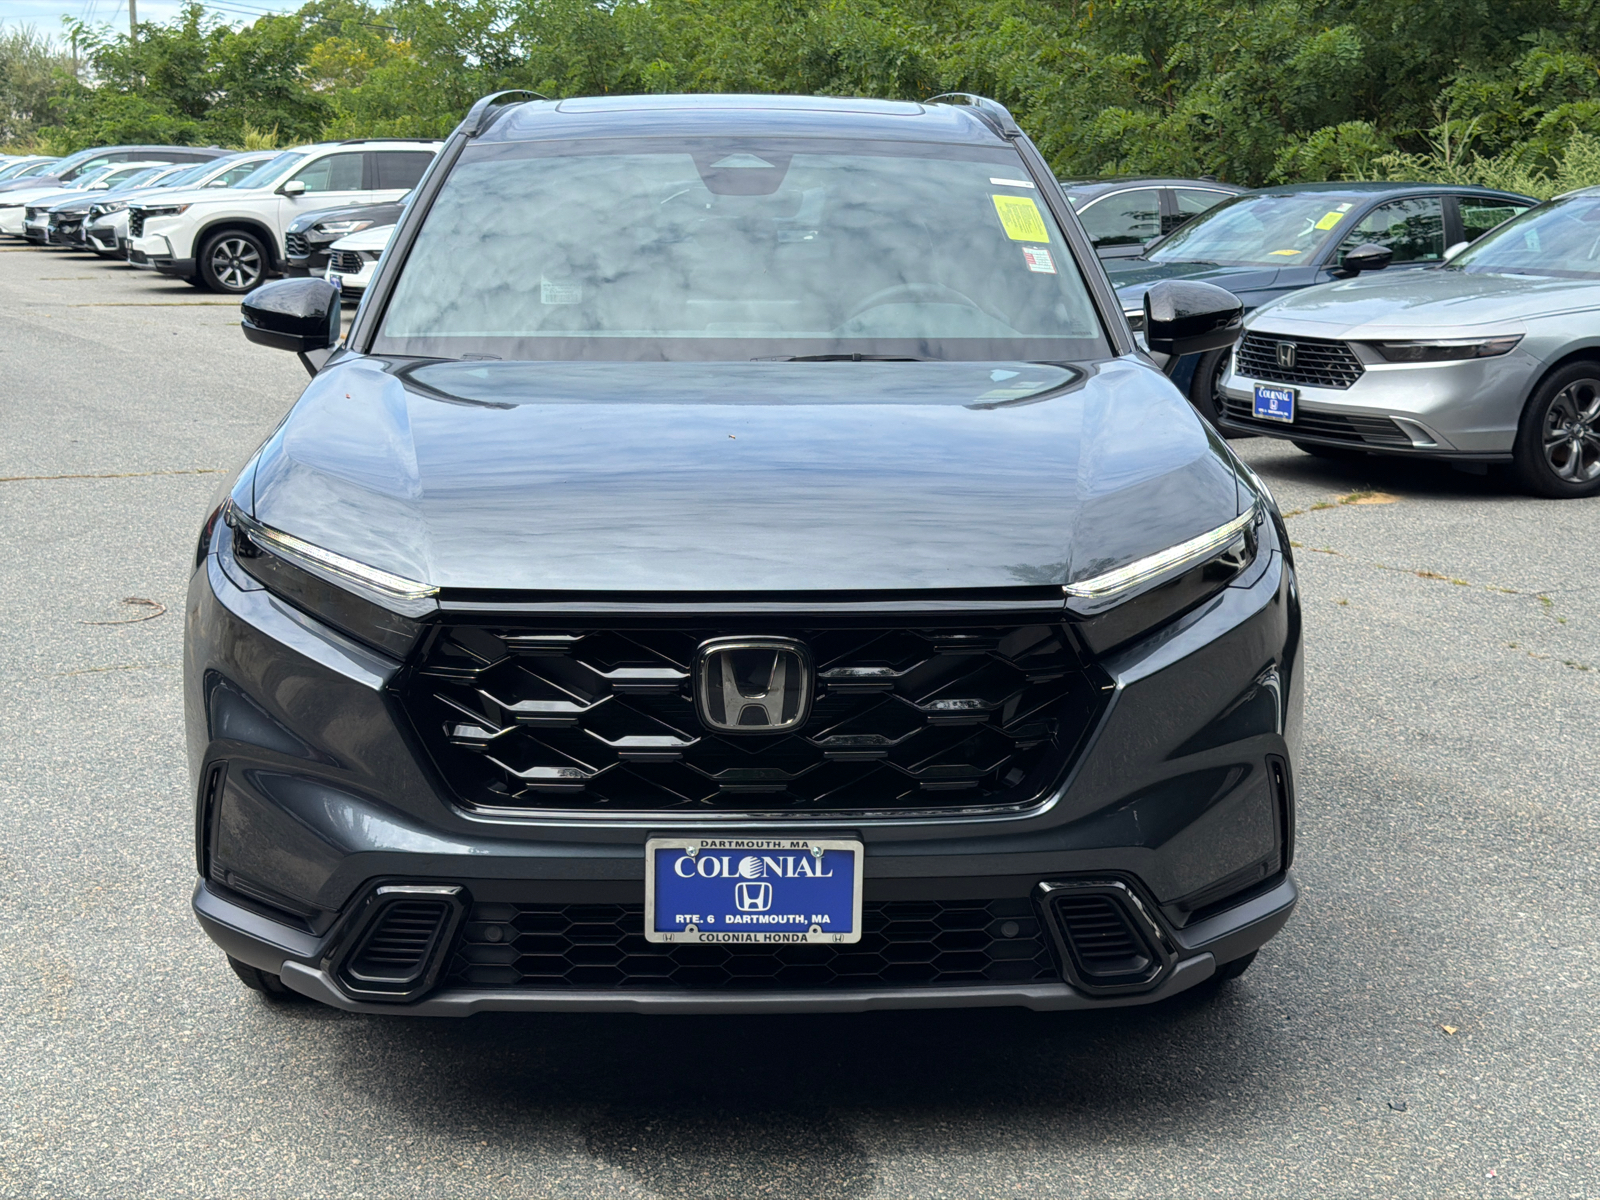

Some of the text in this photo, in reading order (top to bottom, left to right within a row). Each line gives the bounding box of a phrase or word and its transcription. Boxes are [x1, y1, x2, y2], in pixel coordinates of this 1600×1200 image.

[789, 841, 810, 849] MA
[674, 855, 833, 879] COLONIAL
[675, 914, 831, 926] RTE. 6 DARTMOUTH, MA
[698, 932, 809, 943] COLONIAL HONDA
